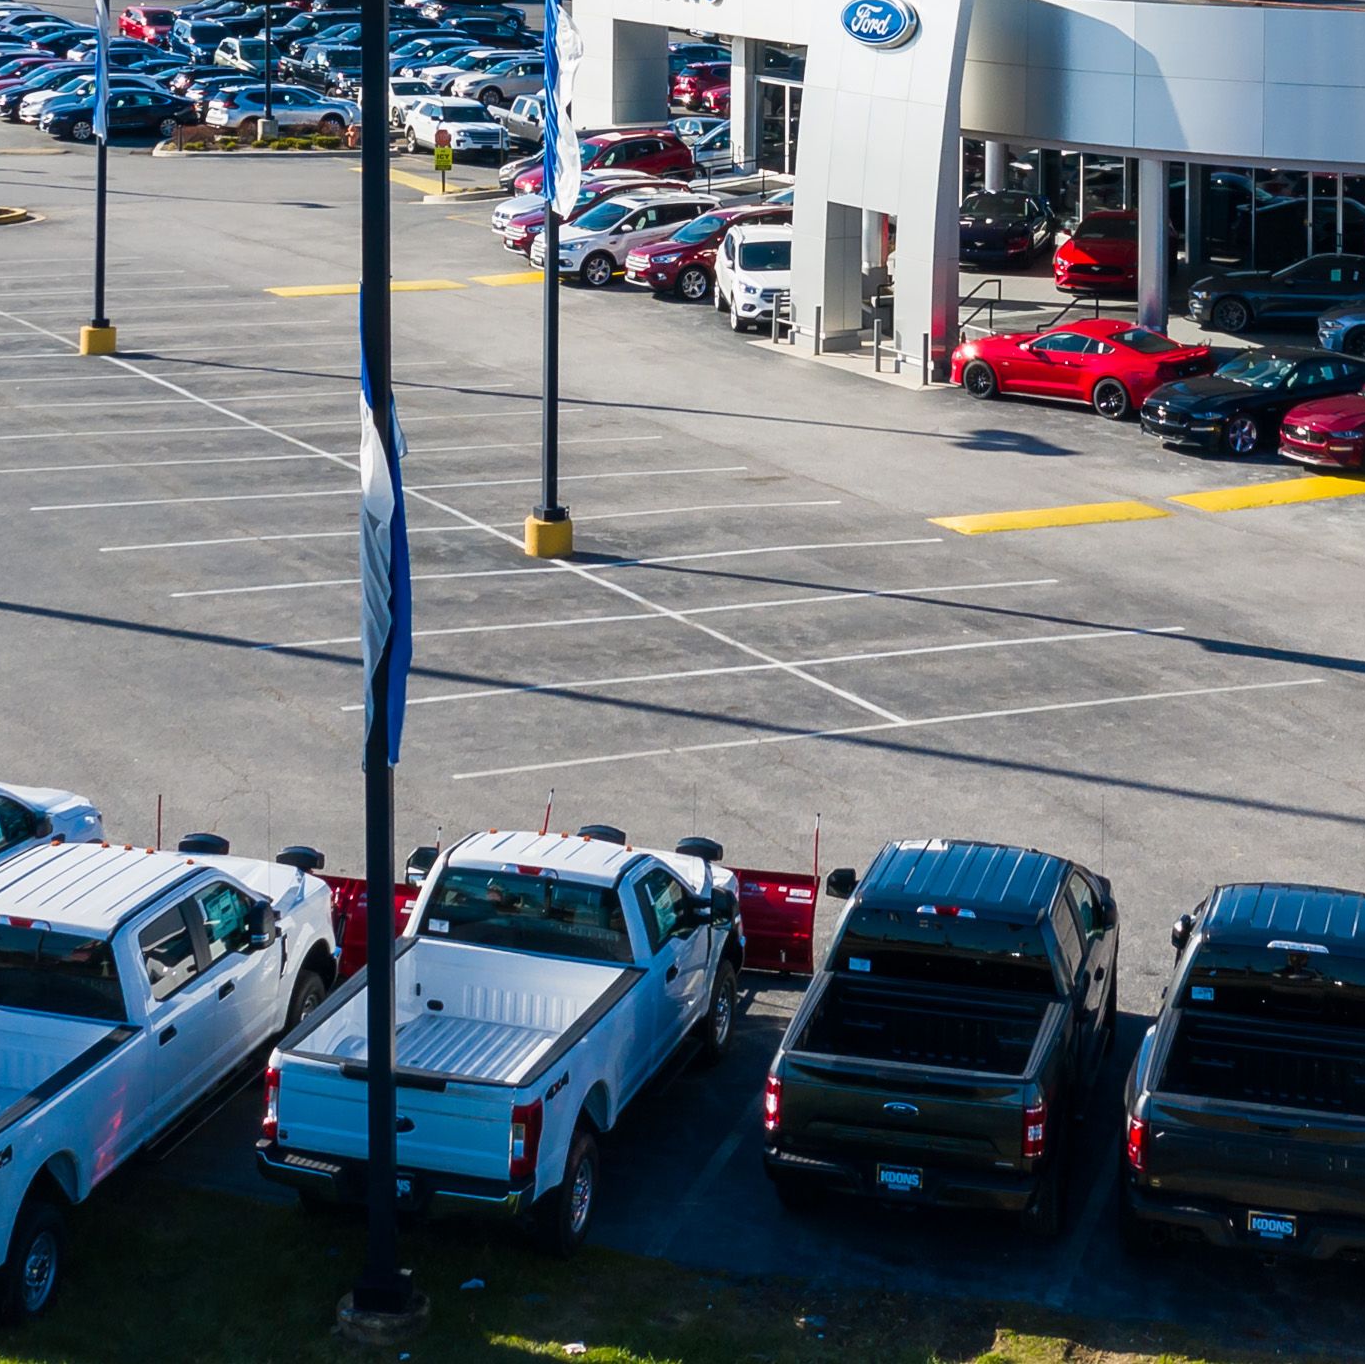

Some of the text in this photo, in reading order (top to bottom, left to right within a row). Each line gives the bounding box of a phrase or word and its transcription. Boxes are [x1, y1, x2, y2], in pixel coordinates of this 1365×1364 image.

[851, 3, 892, 36] Ford
[880, 1170, 920, 1186] KOONS
[1251, 1217, 1293, 1234] KOONS
